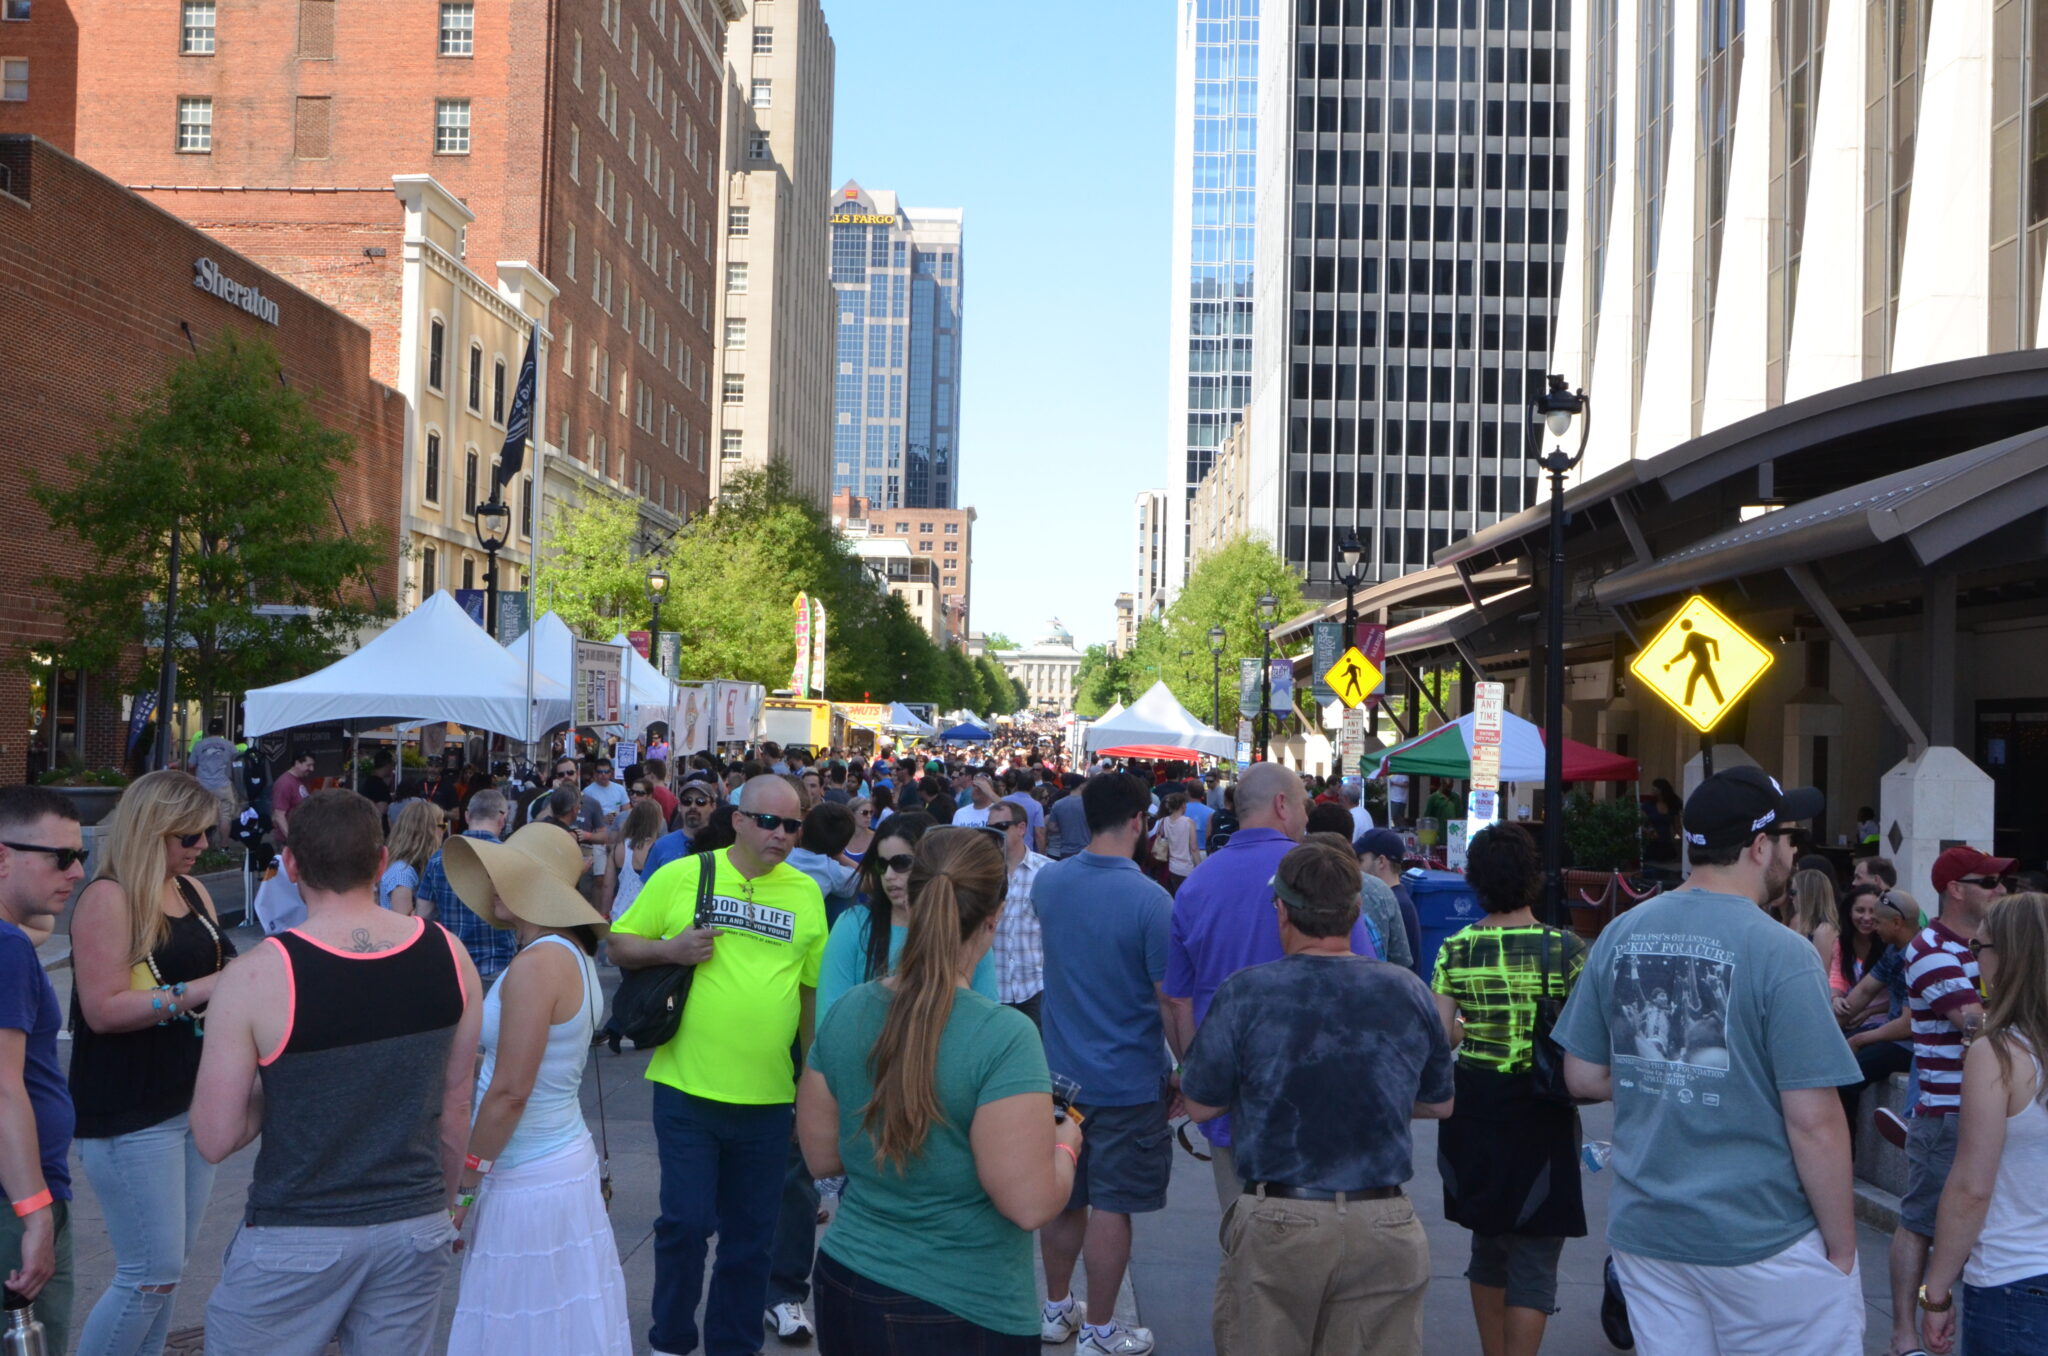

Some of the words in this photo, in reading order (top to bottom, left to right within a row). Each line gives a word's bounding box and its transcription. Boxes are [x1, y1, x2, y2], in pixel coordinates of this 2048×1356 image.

[853, 215, 895, 224] FARGO
[194, 257, 279, 326] Sheraton
[1480, 699, 1497, 709] ANY
[1479, 711, 1498, 721] TIME
[711, 898, 738, 913] OOD
[760, 908, 792, 927] LIFE
[728, 916, 745, 926] AND
[745, 919, 767, 931] SVOR
[767, 926, 790, 937] YOURS
[1686, 934, 1722, 947] ANNUAL
[1685, 943, 1694, 954] A
[1695, 943, 1735, 963] CURE
[1676, 1064, 1726, 1078] FOUNDATION
[1664, 1077, 1686, 1086] 2013
